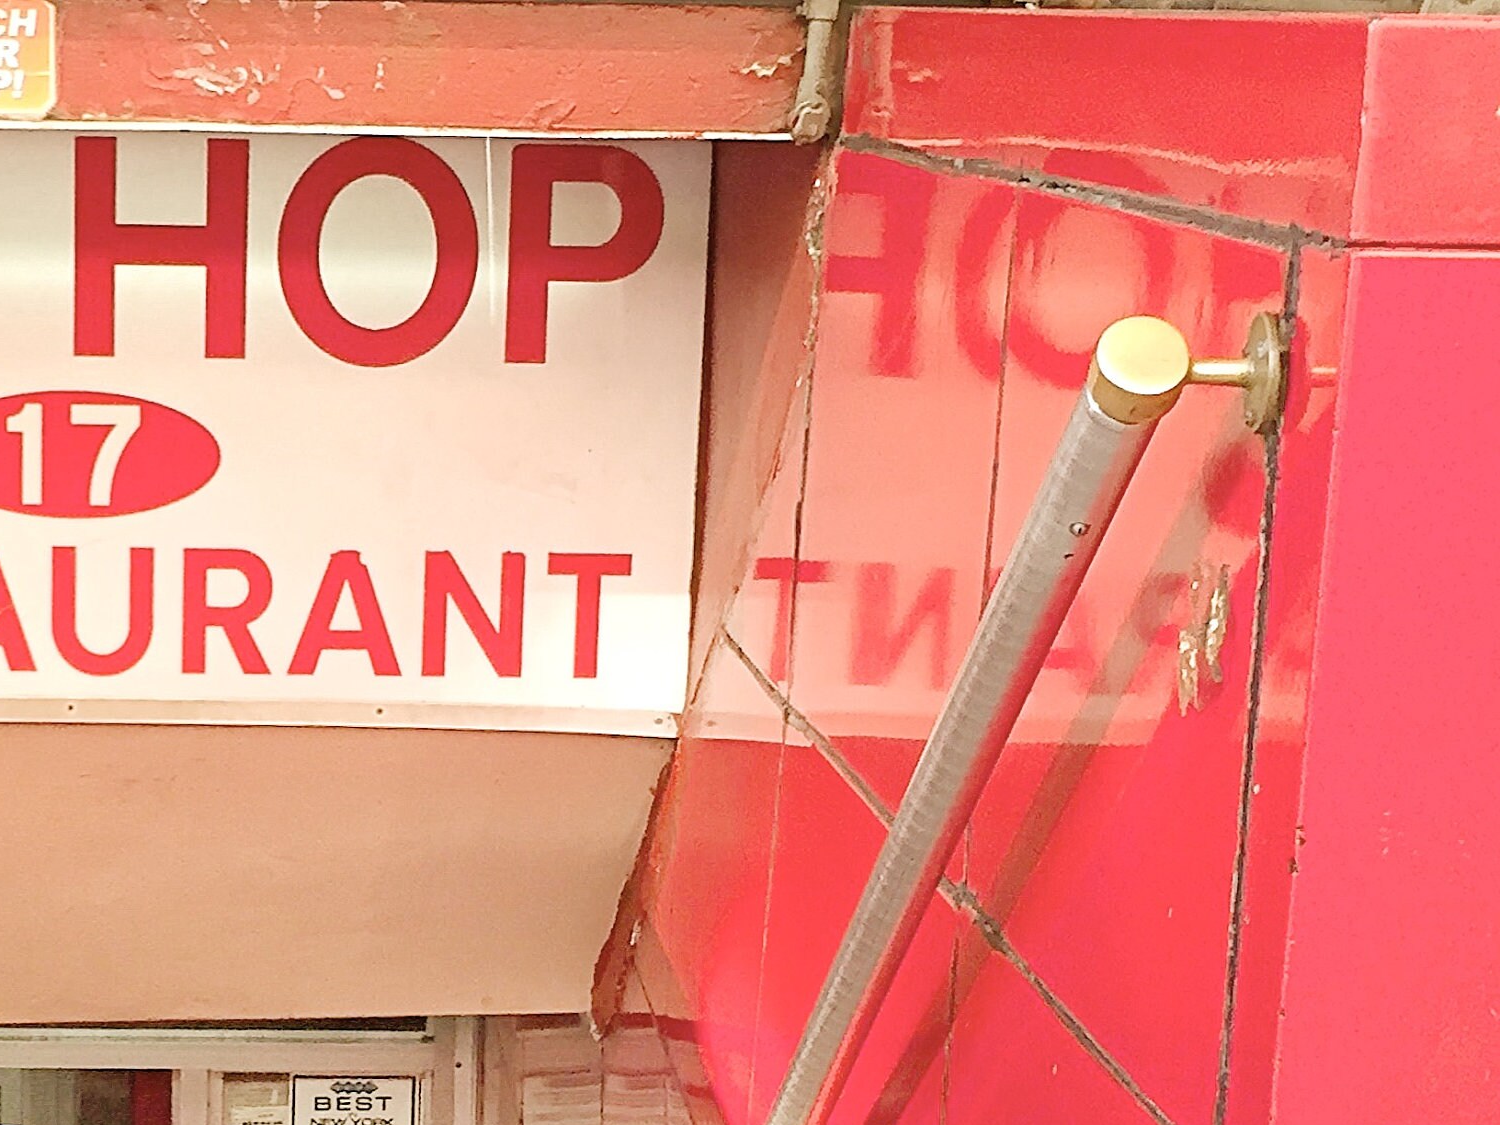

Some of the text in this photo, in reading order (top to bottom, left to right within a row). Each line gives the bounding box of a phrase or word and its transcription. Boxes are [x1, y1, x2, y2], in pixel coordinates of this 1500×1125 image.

[72, 134, 665, 368] HOP
[4, 403, 142, 508] 17
[314, 1096, 392, 1111] BEST
